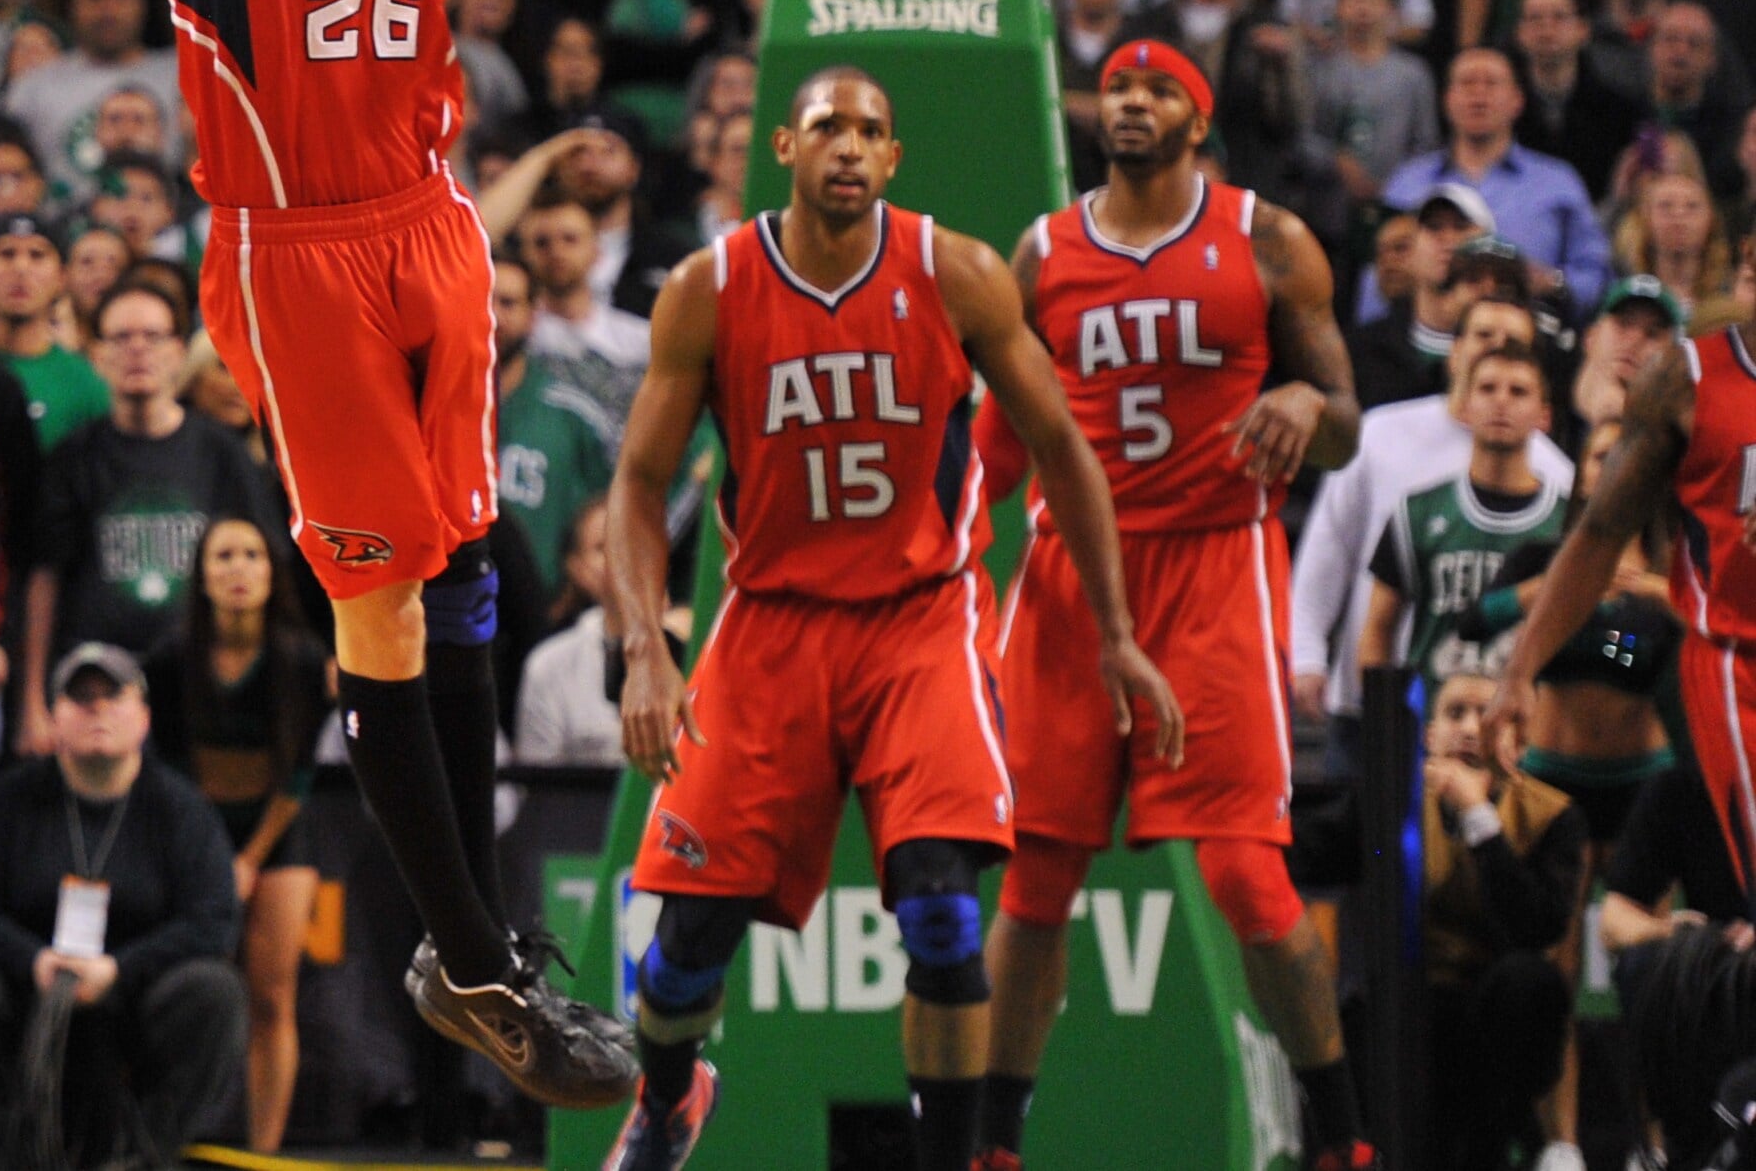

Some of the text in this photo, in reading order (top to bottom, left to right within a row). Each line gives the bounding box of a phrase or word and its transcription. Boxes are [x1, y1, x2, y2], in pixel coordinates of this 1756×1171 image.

[1080, 299, 1224, 379] ATL
[765, 352, 921, 435] ATL
[1121, 384, 1173, 462] 5
[805, 442, 894, 521] 15
[748, 886, 912, 1012] NB
